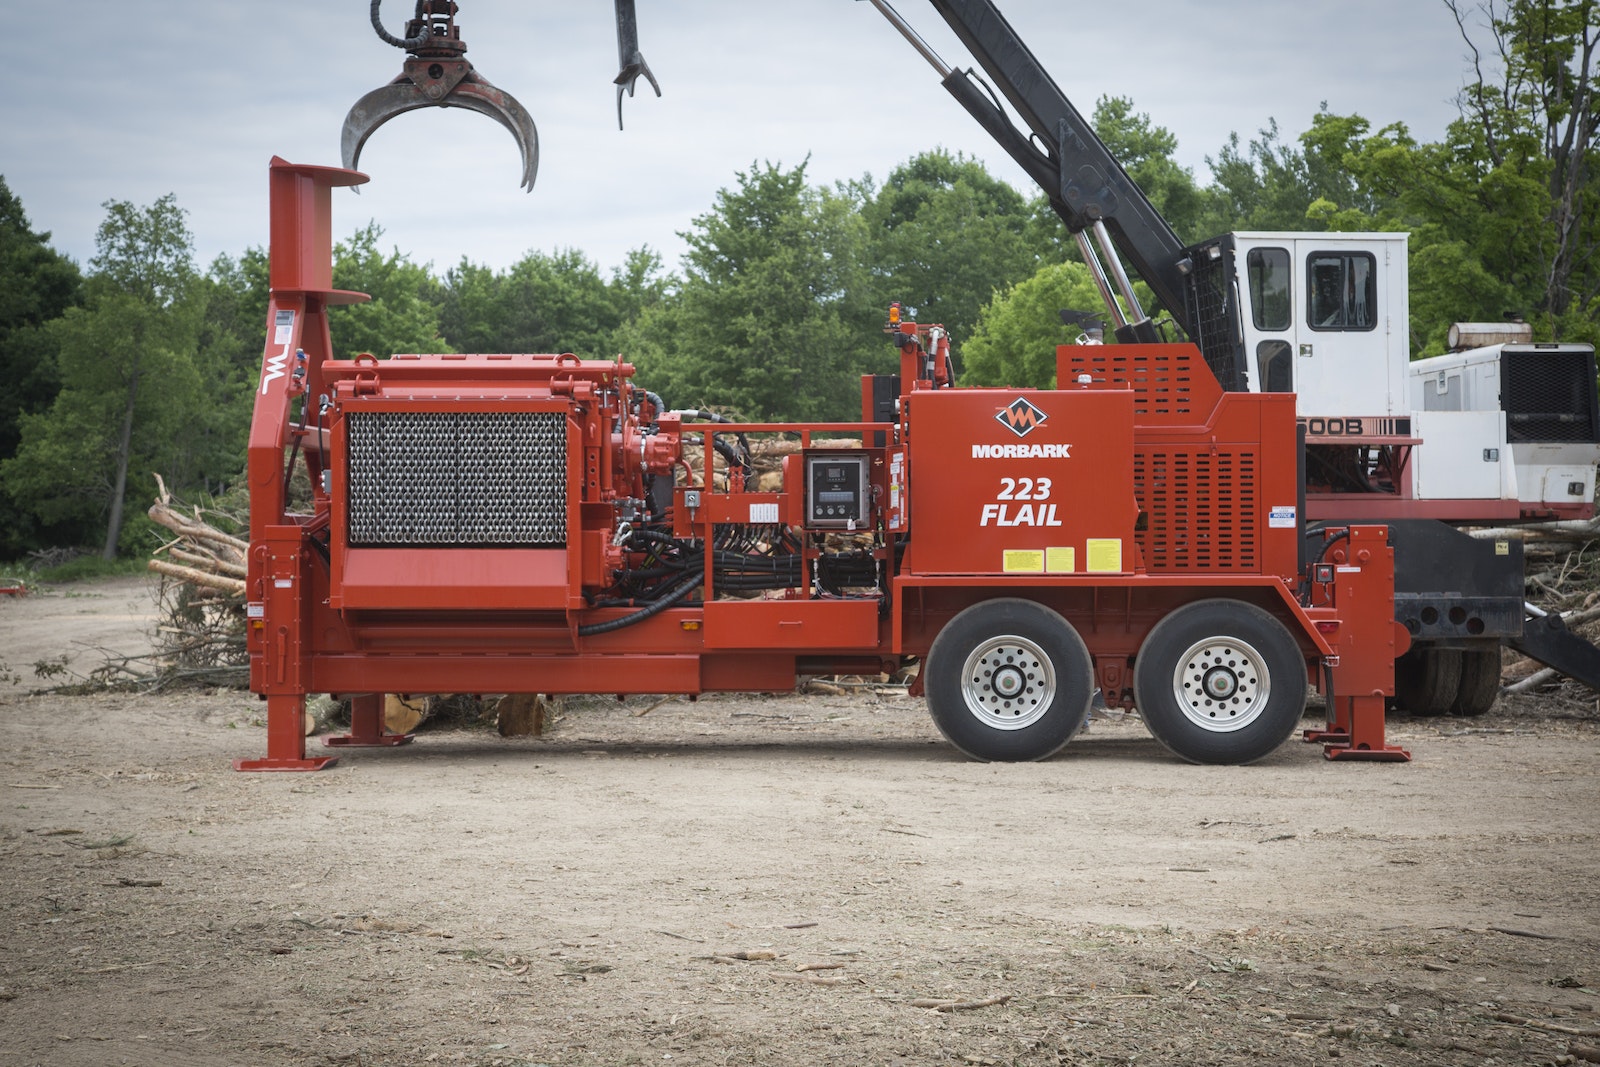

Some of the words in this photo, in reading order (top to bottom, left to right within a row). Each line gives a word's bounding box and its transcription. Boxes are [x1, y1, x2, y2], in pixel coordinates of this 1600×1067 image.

[971, 443, 1072, 459] MORBARK
[996, 477, 1053, 501] 223
[980, 503, 1063, 527] FLAIL
